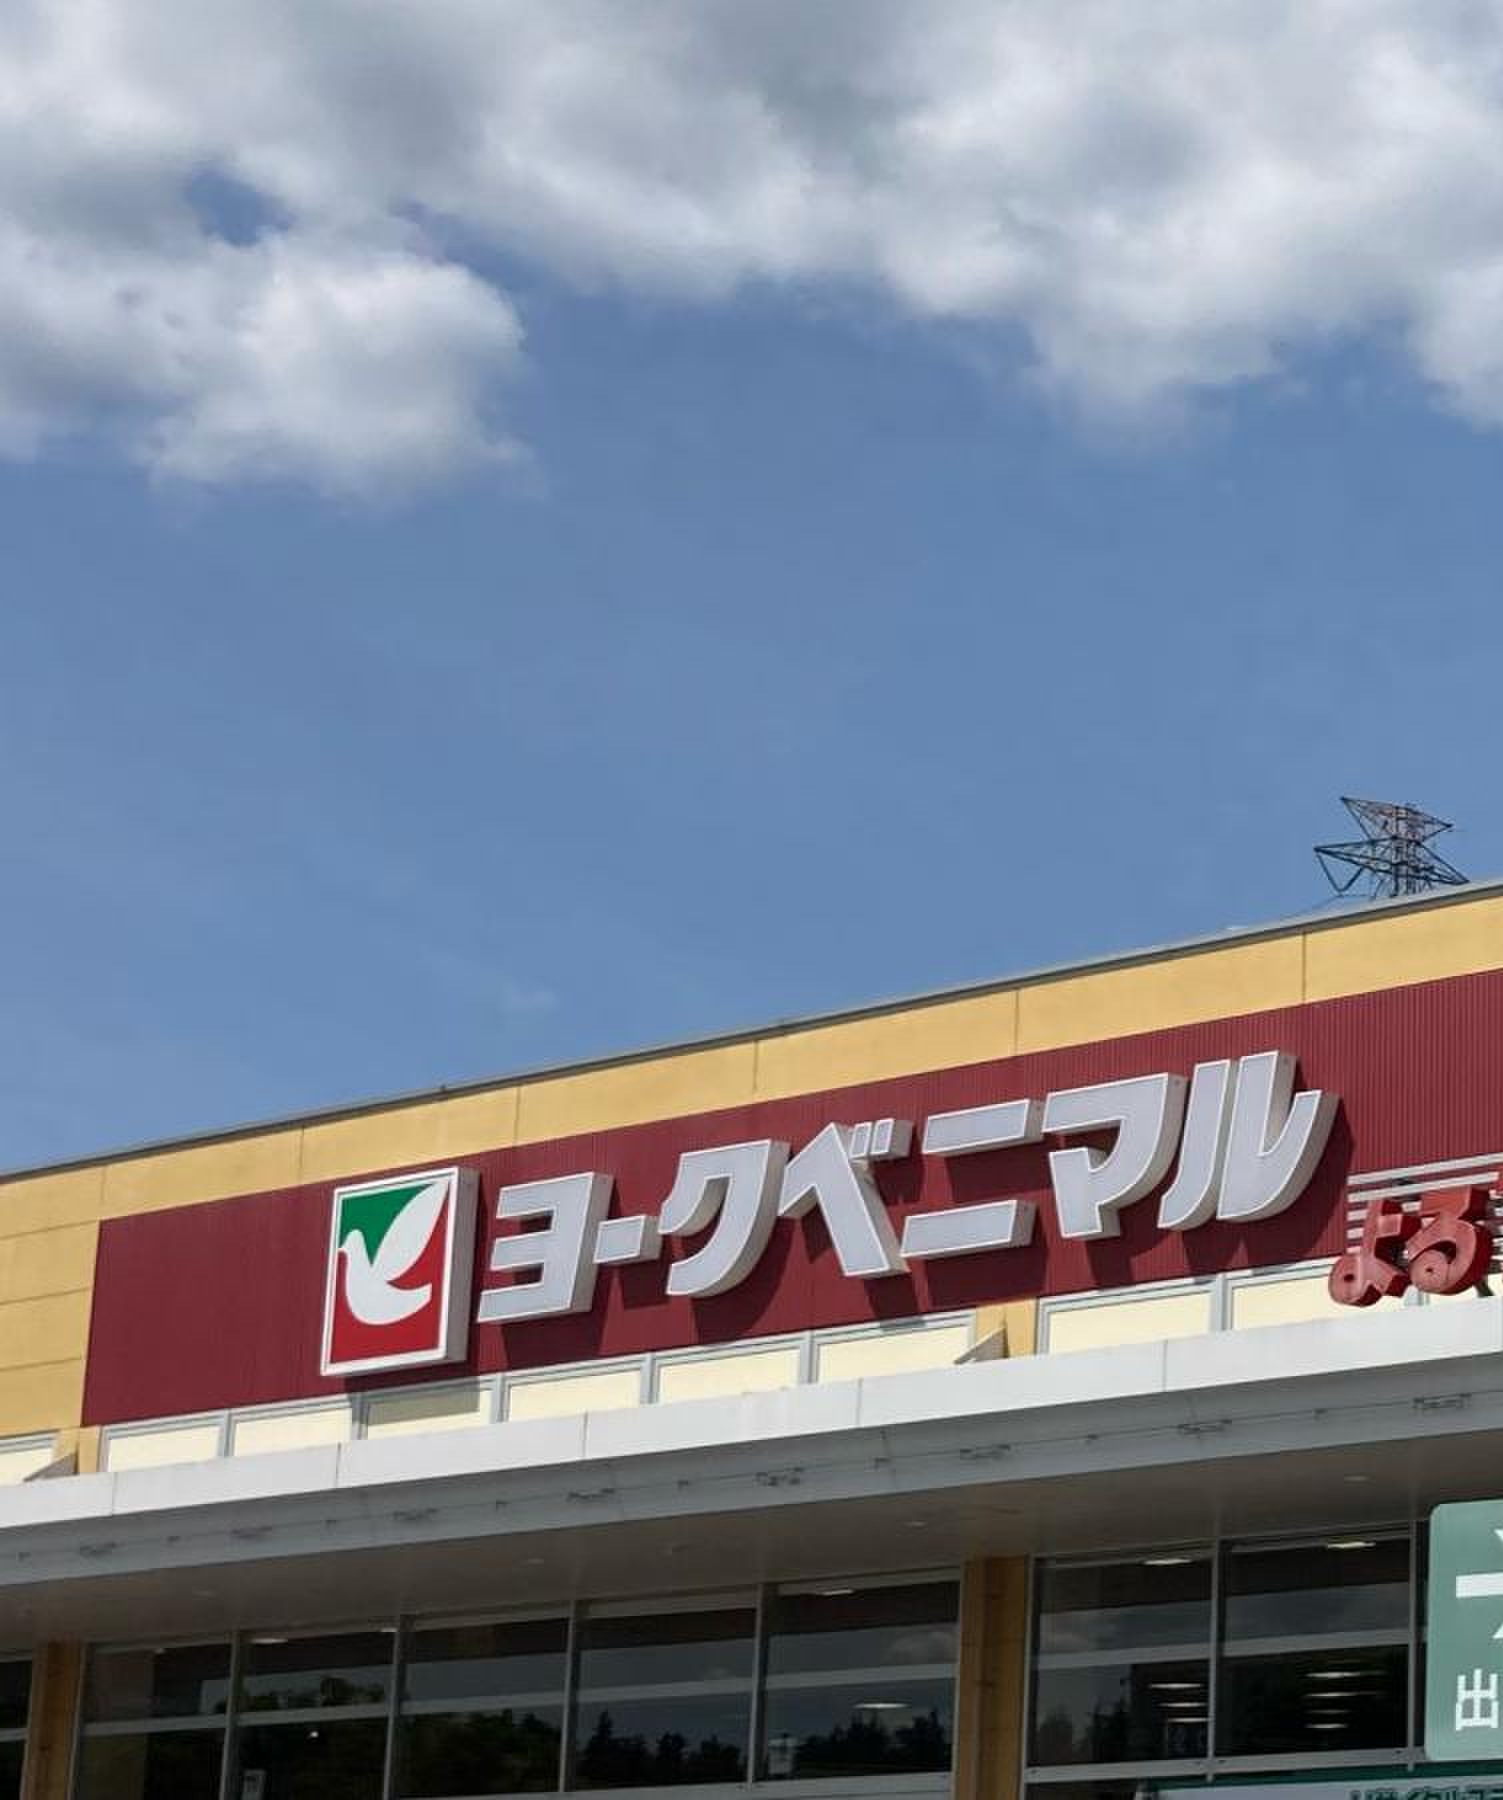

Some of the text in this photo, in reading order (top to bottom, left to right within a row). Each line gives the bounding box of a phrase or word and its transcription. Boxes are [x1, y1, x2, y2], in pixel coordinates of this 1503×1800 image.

[477, 1050, 1340, 1323] ヨークベニマル
